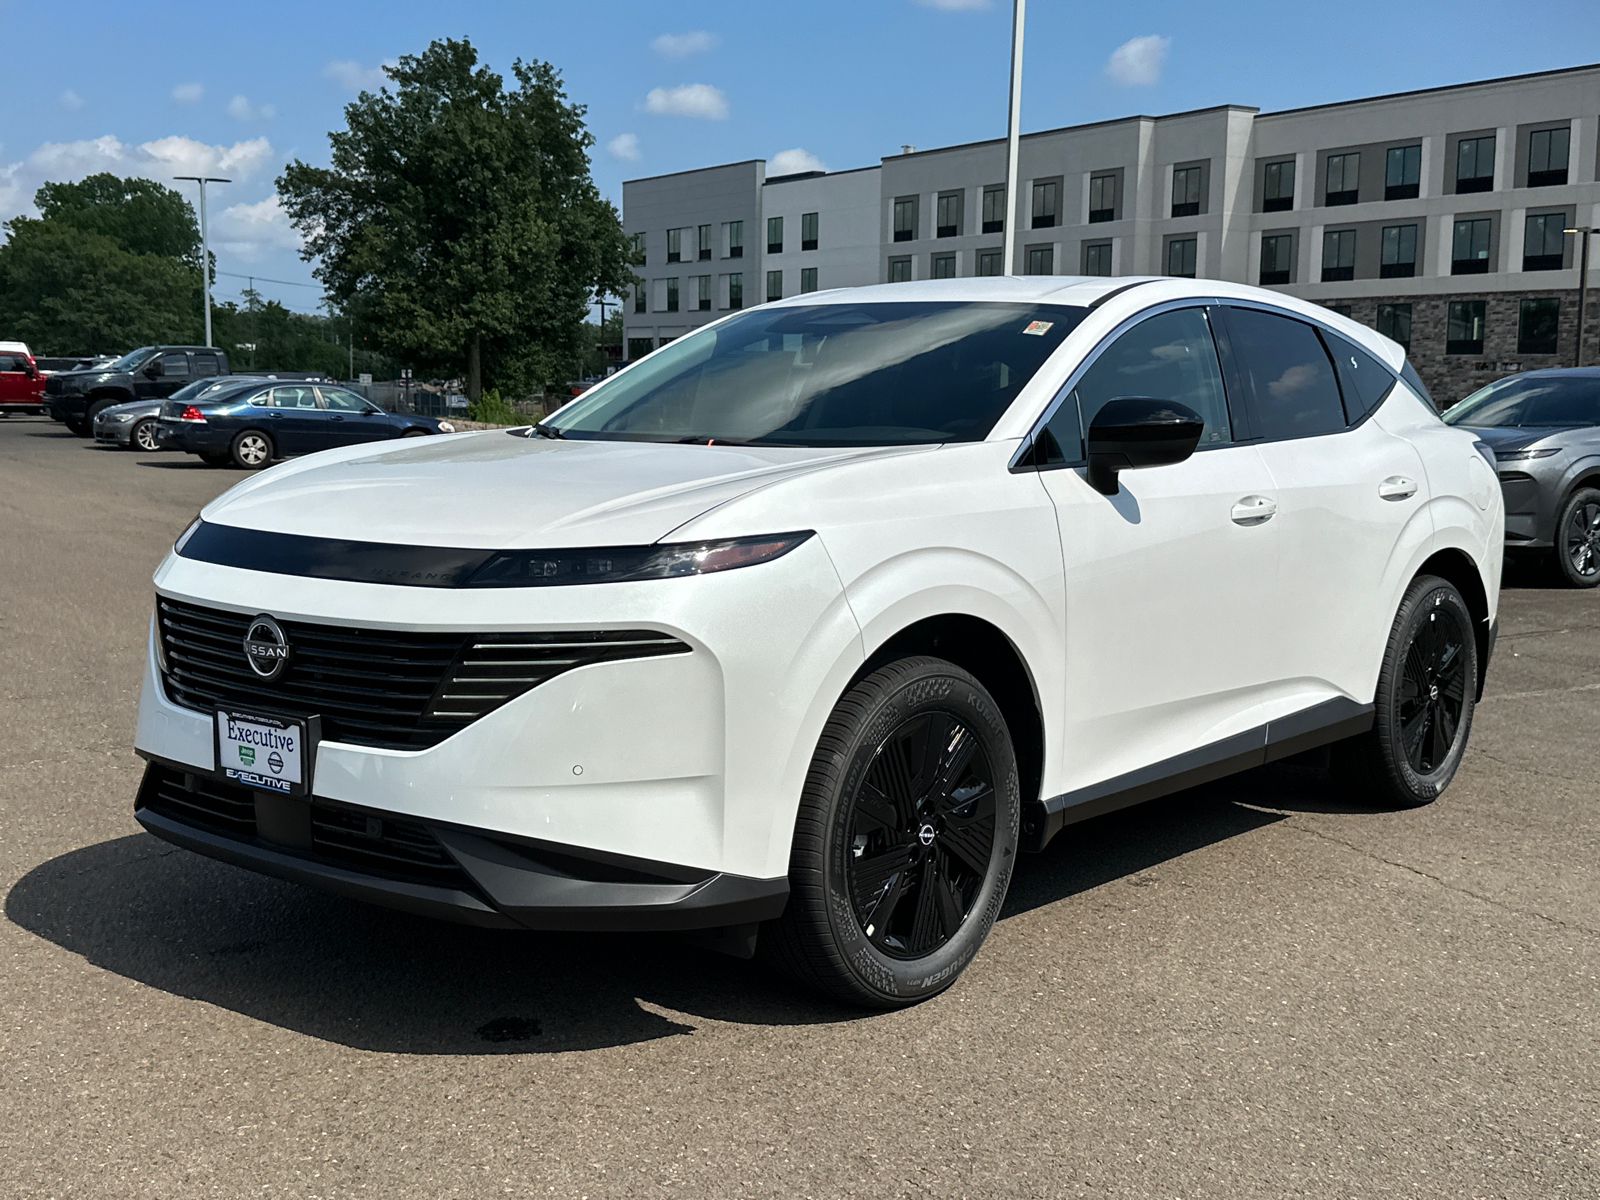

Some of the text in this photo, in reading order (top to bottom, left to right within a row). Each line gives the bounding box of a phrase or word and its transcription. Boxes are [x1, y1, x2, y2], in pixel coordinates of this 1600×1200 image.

[227, 719, 294, 752] Executive
[226, 769, 290, 791] EXECUTIVE
[921, 943, 974, 988] CRUGEN
